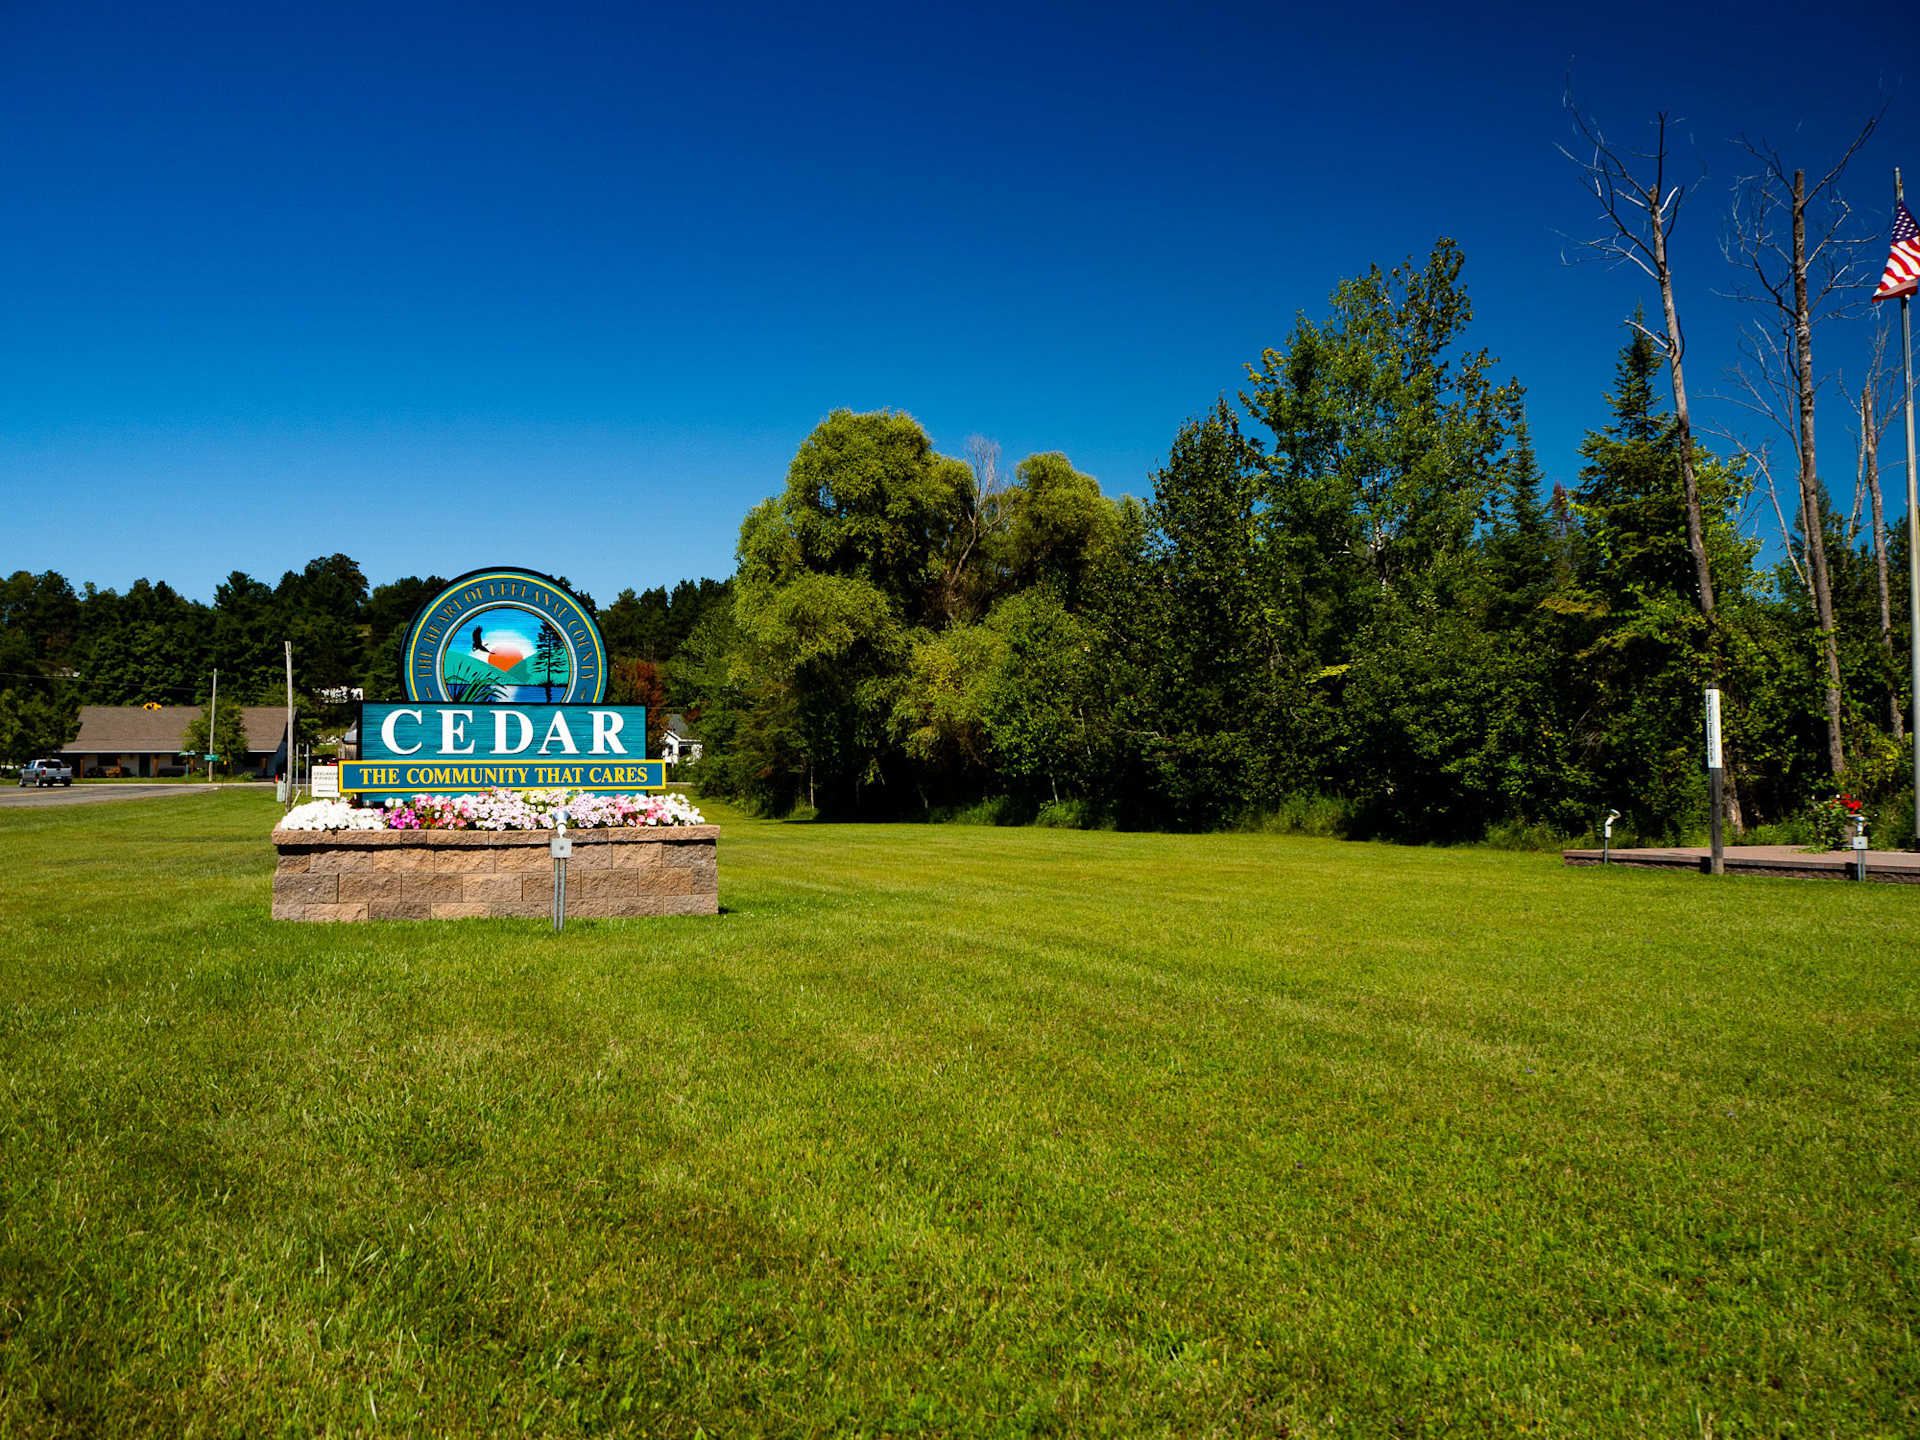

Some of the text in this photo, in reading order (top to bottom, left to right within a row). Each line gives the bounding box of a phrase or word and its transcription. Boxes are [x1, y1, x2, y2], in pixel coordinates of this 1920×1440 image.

[464, 586, 485, 602] OF
[423, 599, 463, 645] HEART
[416, 646, 432, 679] THE
[567, 618, 596, 680] COUNTY
[381, 708, 628, 755] CEDAR
[359, 766, 648, 785] THE COMMUNITY THAT CARES
